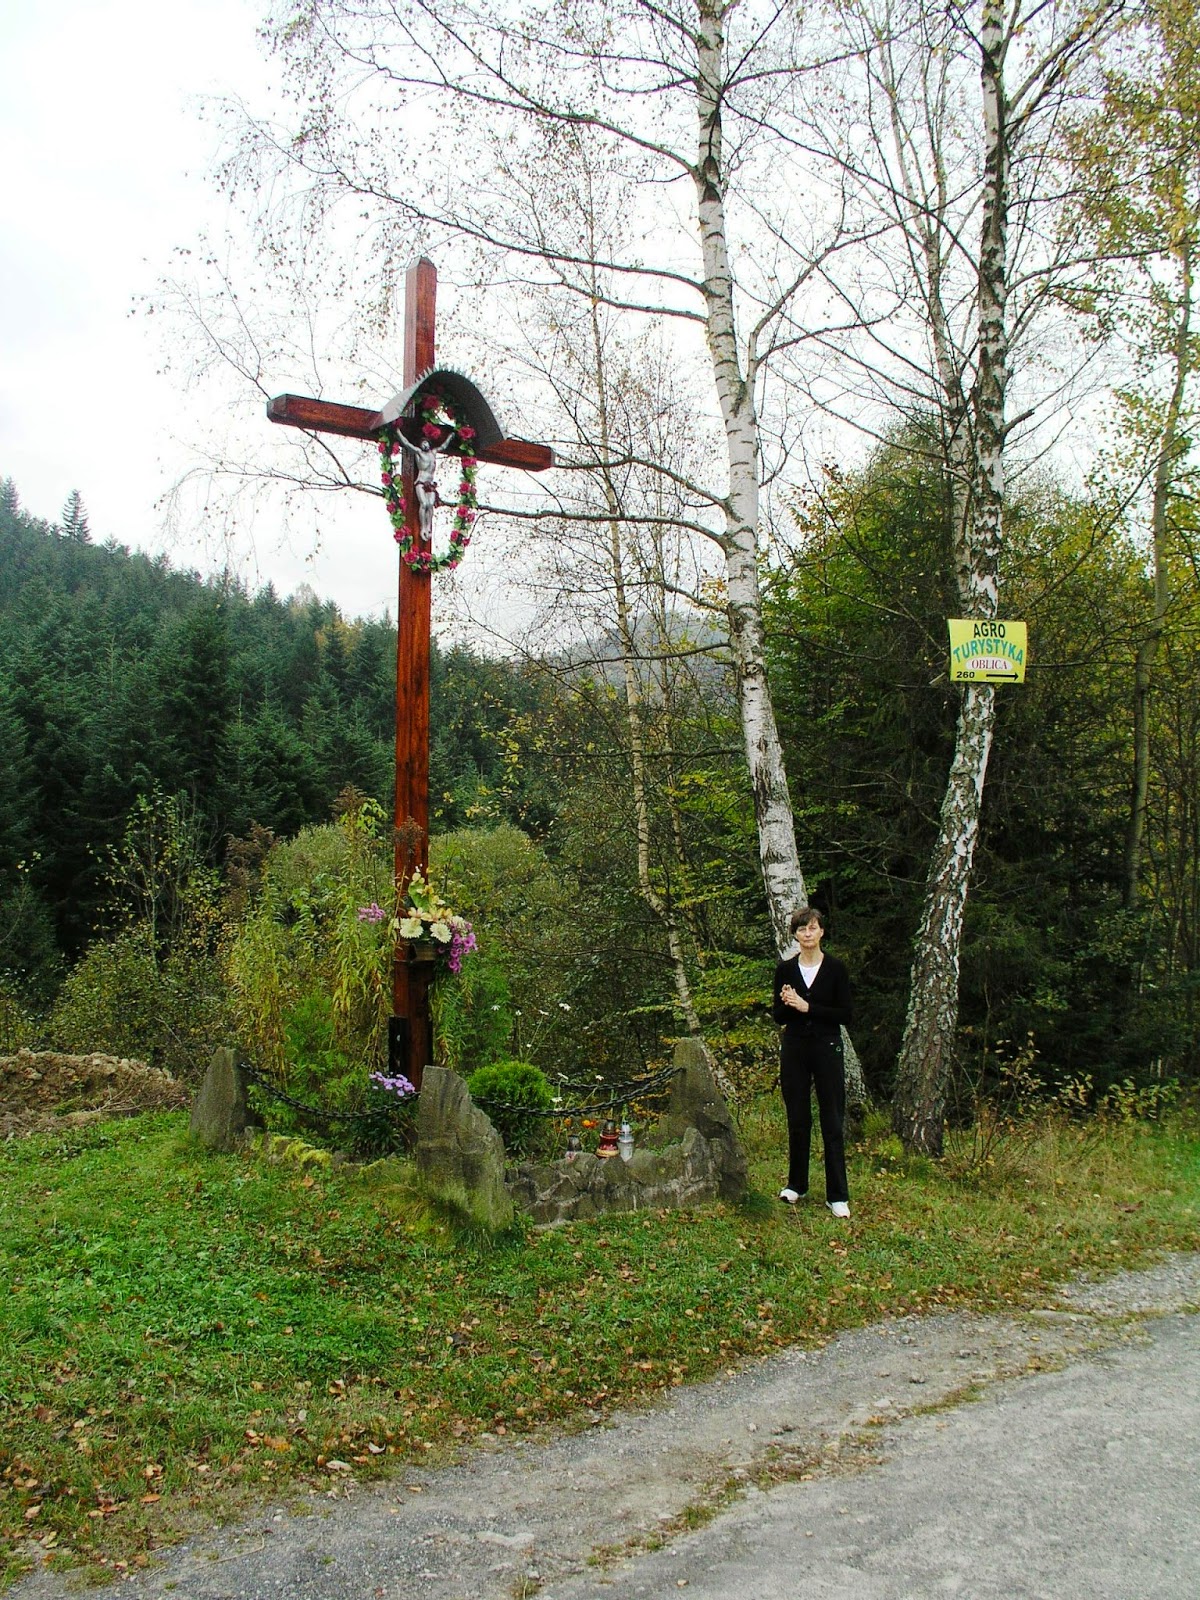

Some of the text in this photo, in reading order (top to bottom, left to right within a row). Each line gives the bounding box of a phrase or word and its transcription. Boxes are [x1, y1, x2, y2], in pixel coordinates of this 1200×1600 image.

[973, 622, 1006, 638] AGRO
[953, 638, 1023, 665] TURYSTYKA
[971, 659, 1008, 670] OBLICA
